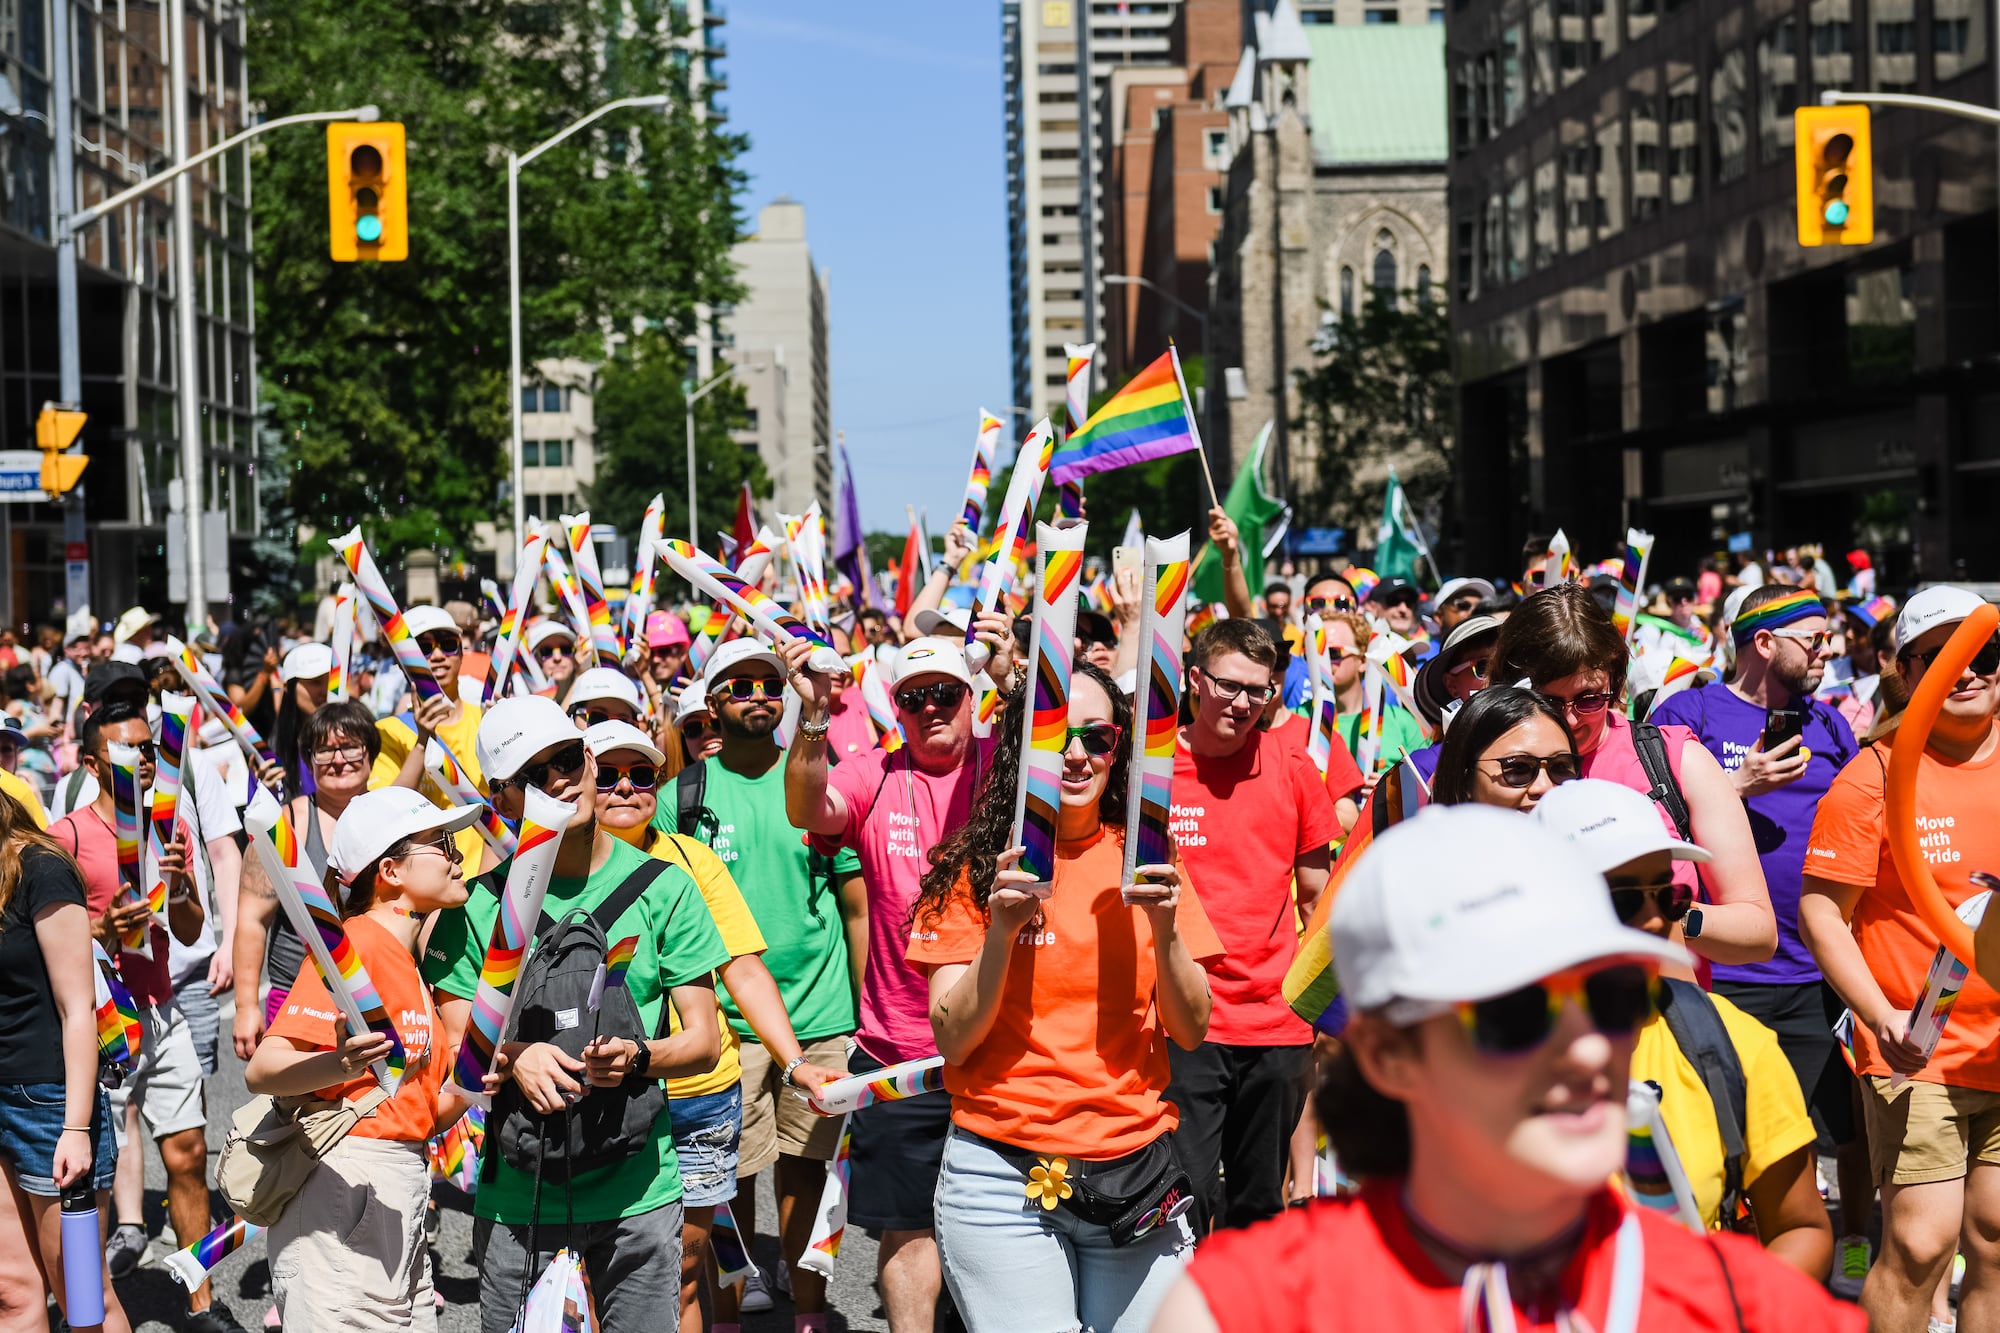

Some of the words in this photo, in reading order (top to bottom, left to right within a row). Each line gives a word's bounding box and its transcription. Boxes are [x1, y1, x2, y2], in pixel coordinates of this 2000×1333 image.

[501, 731, 523, 748] Manulife
[1169, 804, 1205, 817] Move
[1169, 819, 1199, 832] with
[1915, 815, 1955, 831] Move
[890, 828, 914, 842] with
[1019, 928, 1056, 947] ride
[302, 1007, 337, 1022] Manulife
